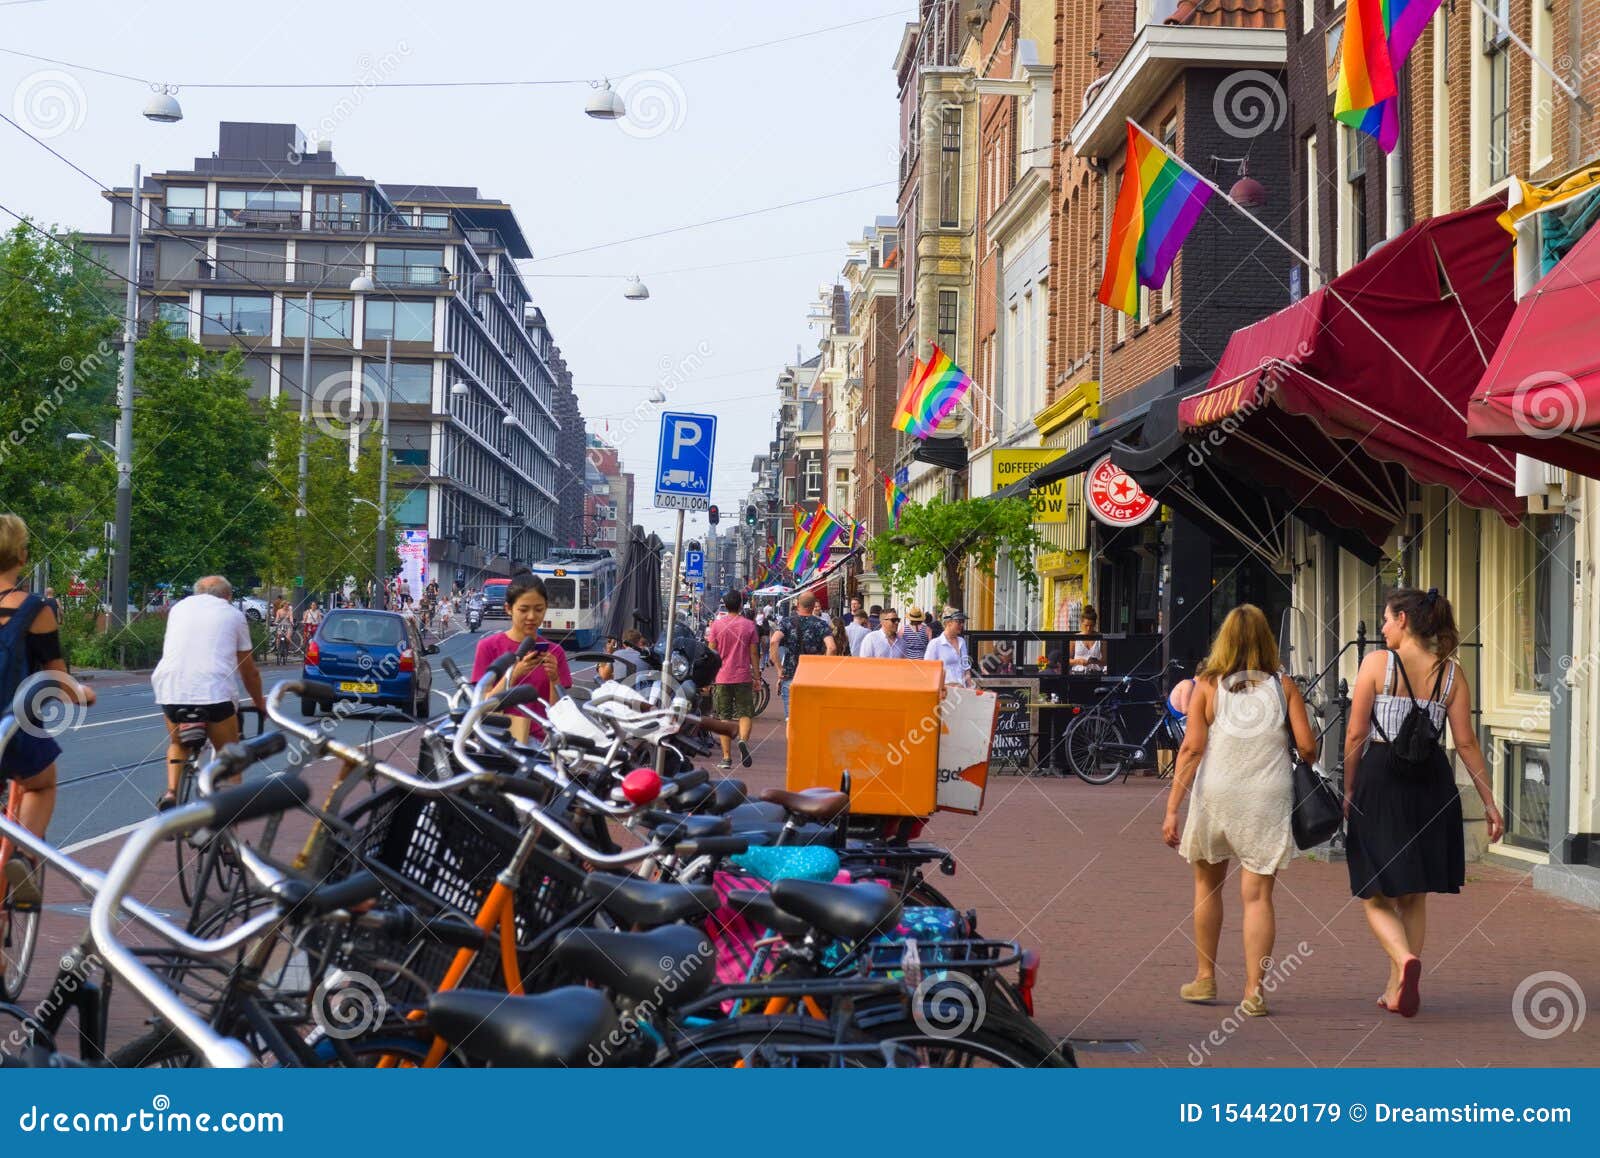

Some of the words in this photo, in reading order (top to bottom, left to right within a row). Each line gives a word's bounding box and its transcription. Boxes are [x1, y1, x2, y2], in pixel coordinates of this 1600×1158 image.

[672, 420, 702, 460] P
[998, 462, 1048, 474] COFFEES
[1100, 500, 1133, 518] Bier
